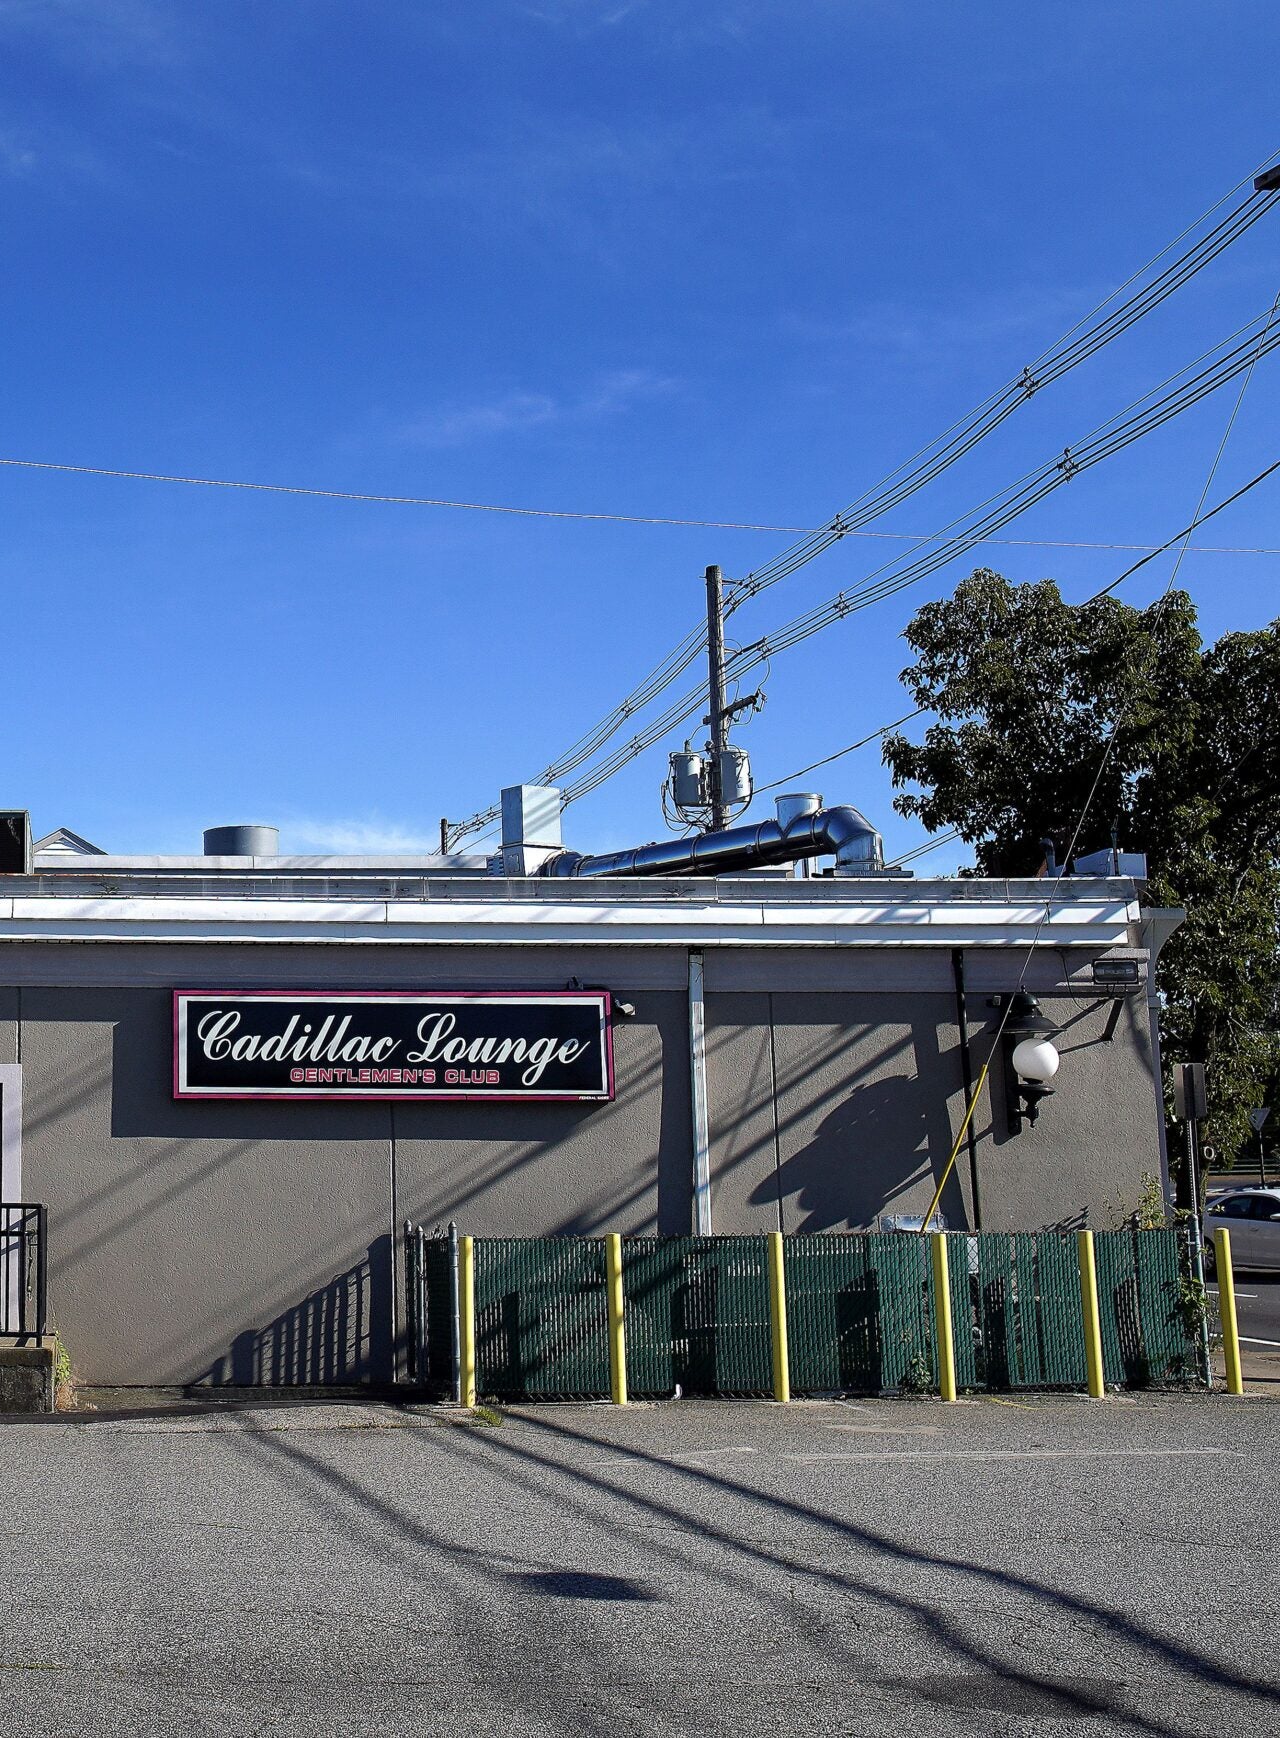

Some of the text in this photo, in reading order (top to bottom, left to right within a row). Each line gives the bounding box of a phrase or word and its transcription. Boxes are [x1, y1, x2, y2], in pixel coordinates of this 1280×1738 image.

[197, 1010, 591, 1086] Cadillac Lounge
[289, 1067, 500, 1084] GENTLEMEN'S CLUB
